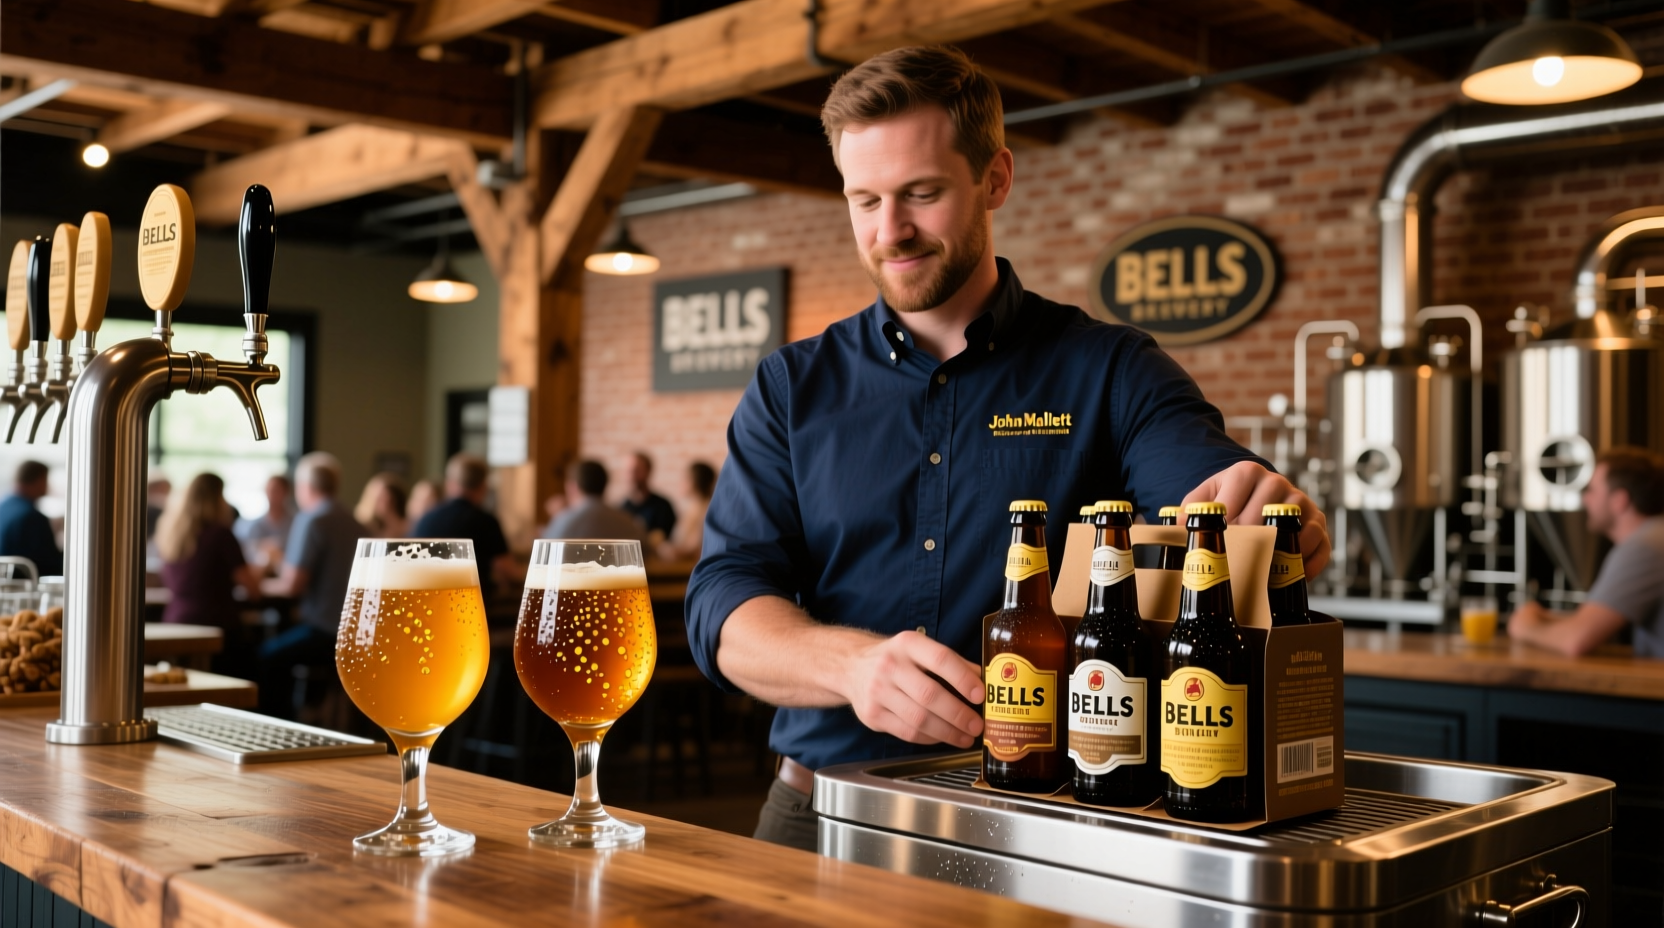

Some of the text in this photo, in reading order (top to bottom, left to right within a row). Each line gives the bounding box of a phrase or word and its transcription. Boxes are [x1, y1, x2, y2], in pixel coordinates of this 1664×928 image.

[143, 222, 176, 246] BELLS
[1115, 241, 1248, 305] BELLS
[662, 287, 771, 353] BELLS
[989, 411, 1072, 429] John Mallett
[987, 683, 1045, 707] BELLS
[1072, 692, 1134, 718] BELLS
[1165, 701, 1234, 728] BELLS
